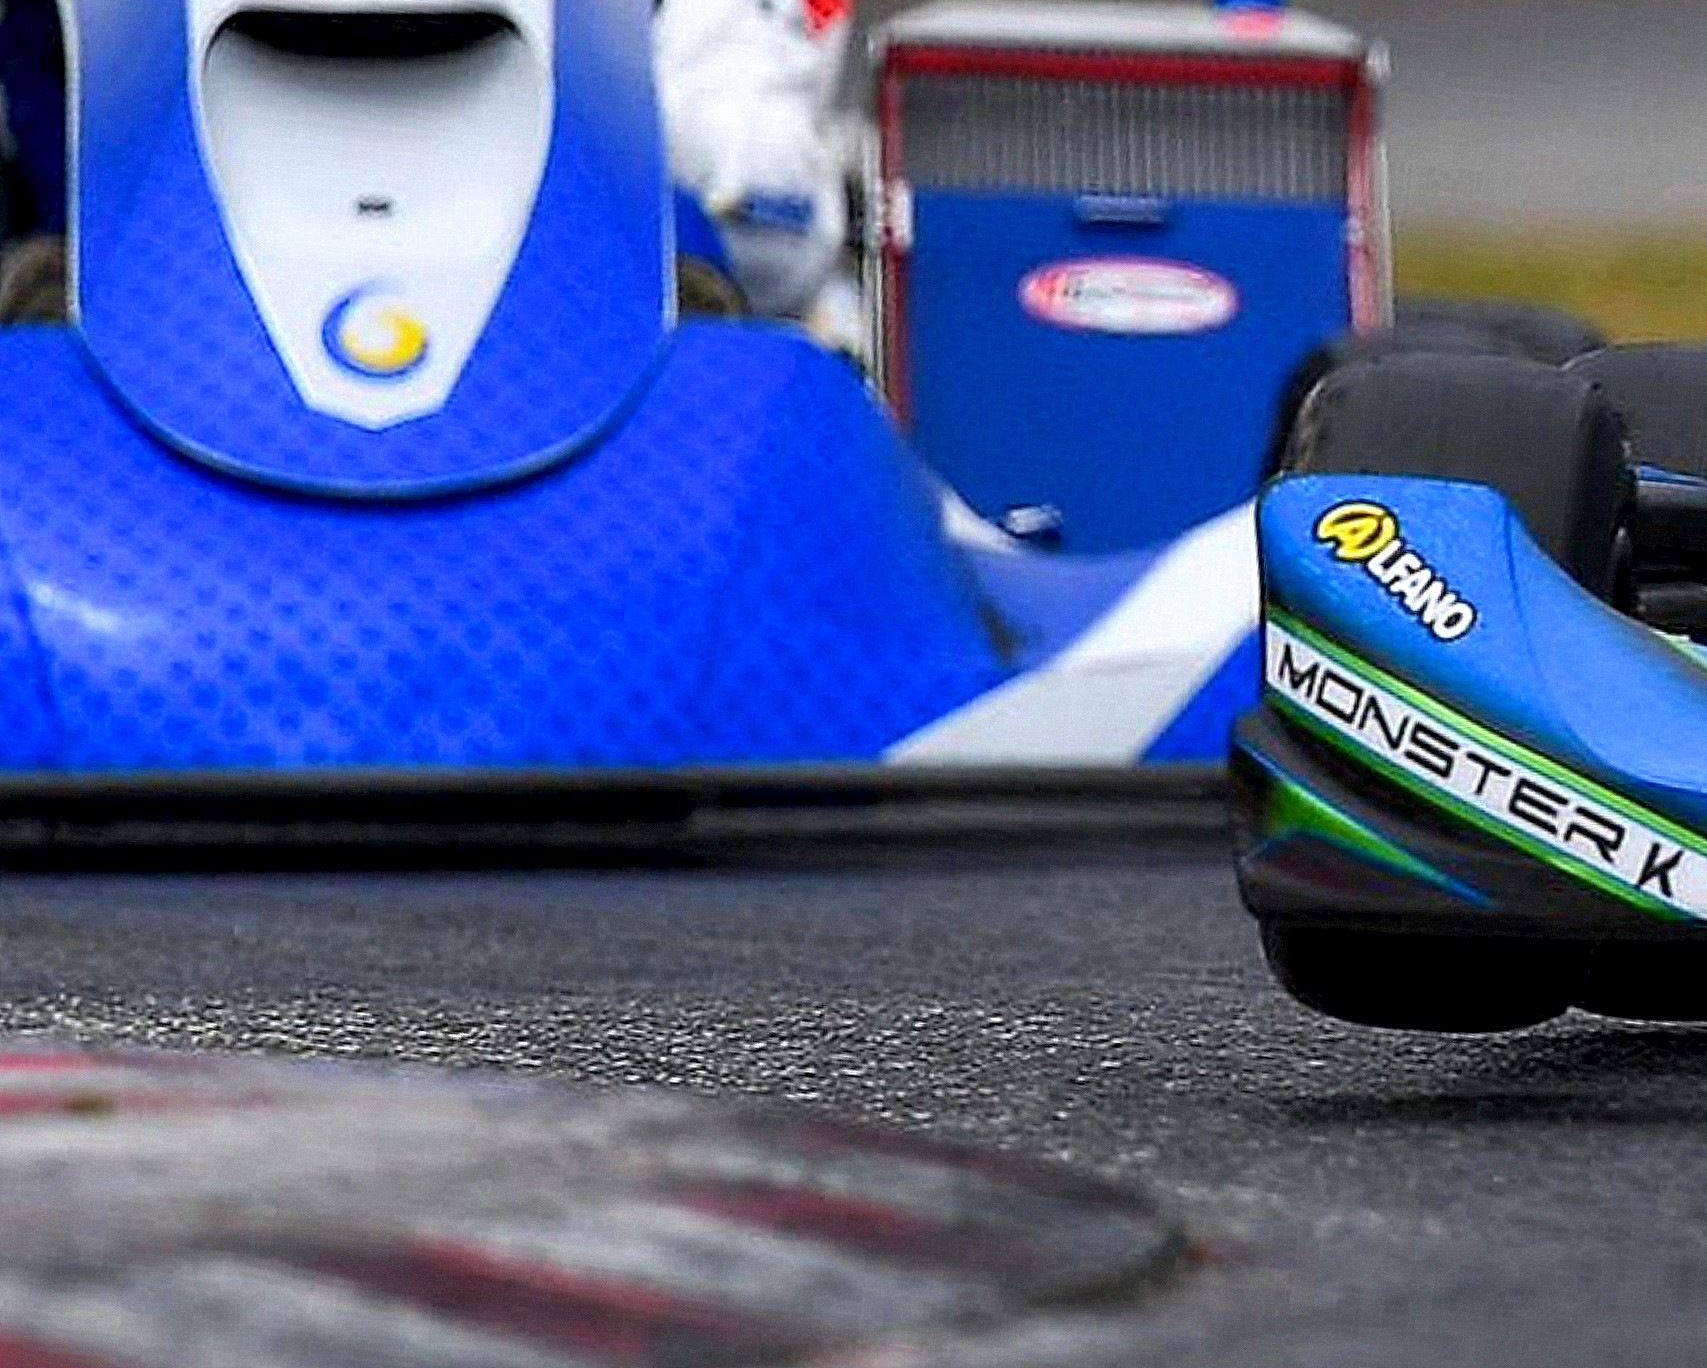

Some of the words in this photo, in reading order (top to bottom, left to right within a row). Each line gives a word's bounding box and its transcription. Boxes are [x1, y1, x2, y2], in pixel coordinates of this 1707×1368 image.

[1317, 501, 1476, 642] ALFANO
[1276, 643, 1628, 865] MONSTER
[1637, 850, 1685, 899] K
